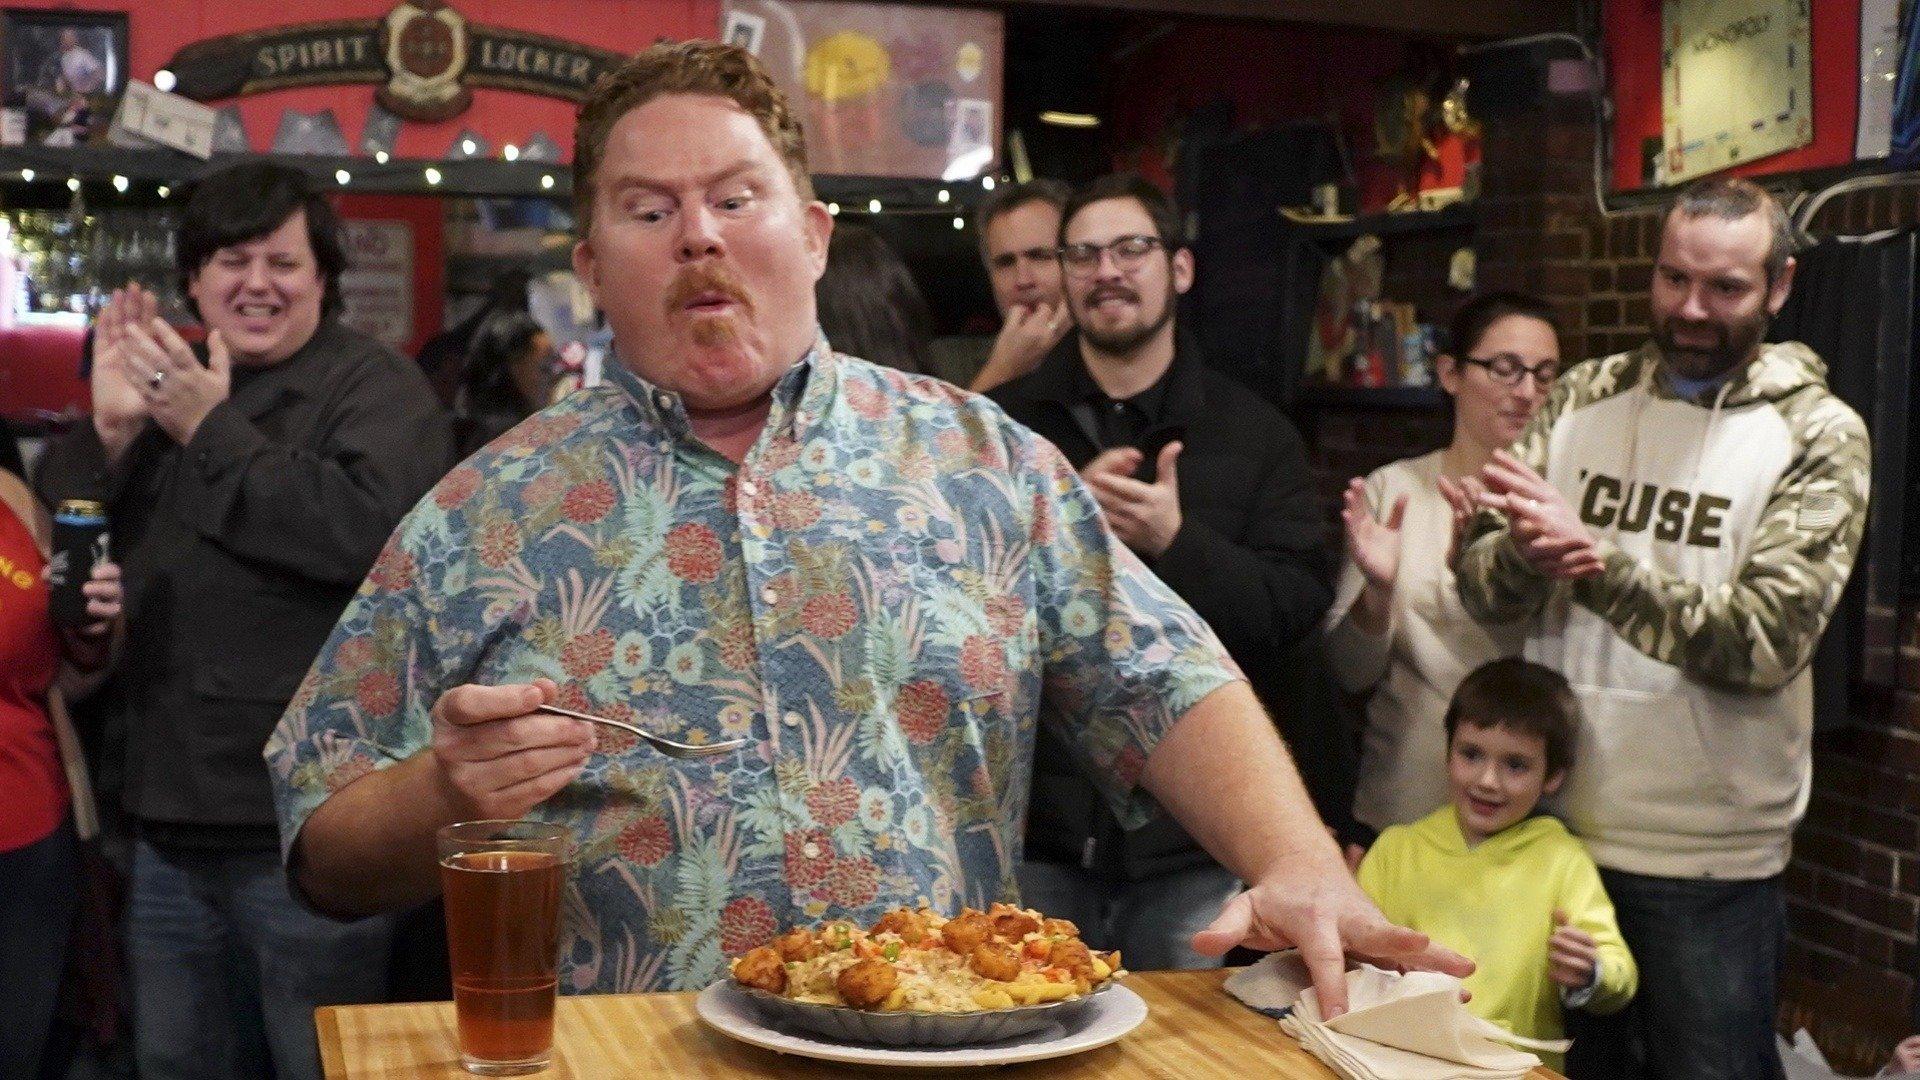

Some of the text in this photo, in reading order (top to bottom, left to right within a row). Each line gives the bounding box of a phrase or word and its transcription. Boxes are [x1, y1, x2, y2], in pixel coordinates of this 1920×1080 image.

[256, 35, 591, 83] SPIRIT LOCKER
[1580, 468, 1732, 548] 'CUSE
